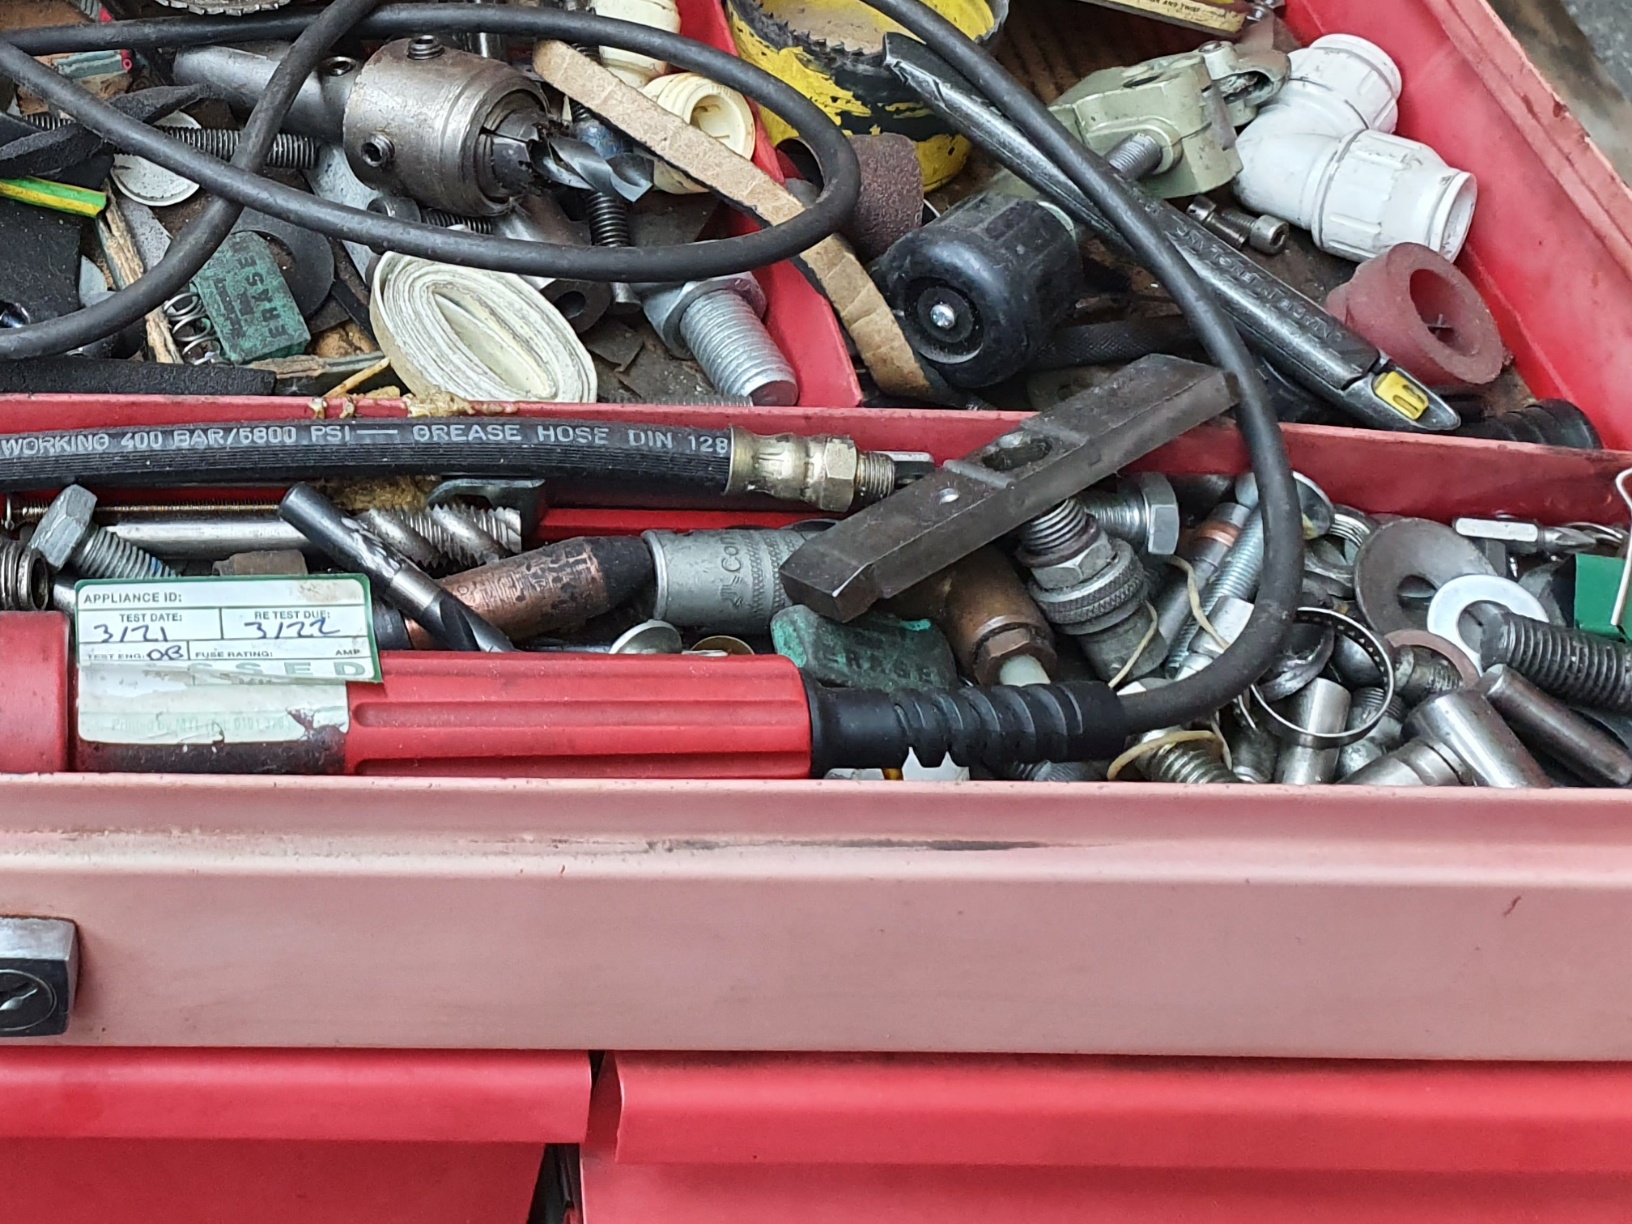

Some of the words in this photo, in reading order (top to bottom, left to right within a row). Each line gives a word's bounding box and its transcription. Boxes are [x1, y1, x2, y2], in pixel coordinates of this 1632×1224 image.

[1, 433, 109, 456] WORKING
[120, 430, 163, 450] 400
[310, 424, 350, 444] PSI
[413, 422, 522, 443] GREASE
[537, 424, 610, 445] HOSE
[628, 428, 674, 449] DIN
[83, 592, 160, 605] APPLIANCE
[163, 592, 183, 604] ID:
[119, 613, 147, 623] TEST
[150, 612, 183, 623] DATE:
[254, 611, 269, 620] RE
[271, 610, 301, 620] TEST
[304, 610, 331, 620] DUE:
[195, 650, 225, 659] FUSE
[228, 649, 273, 658] RATING:
